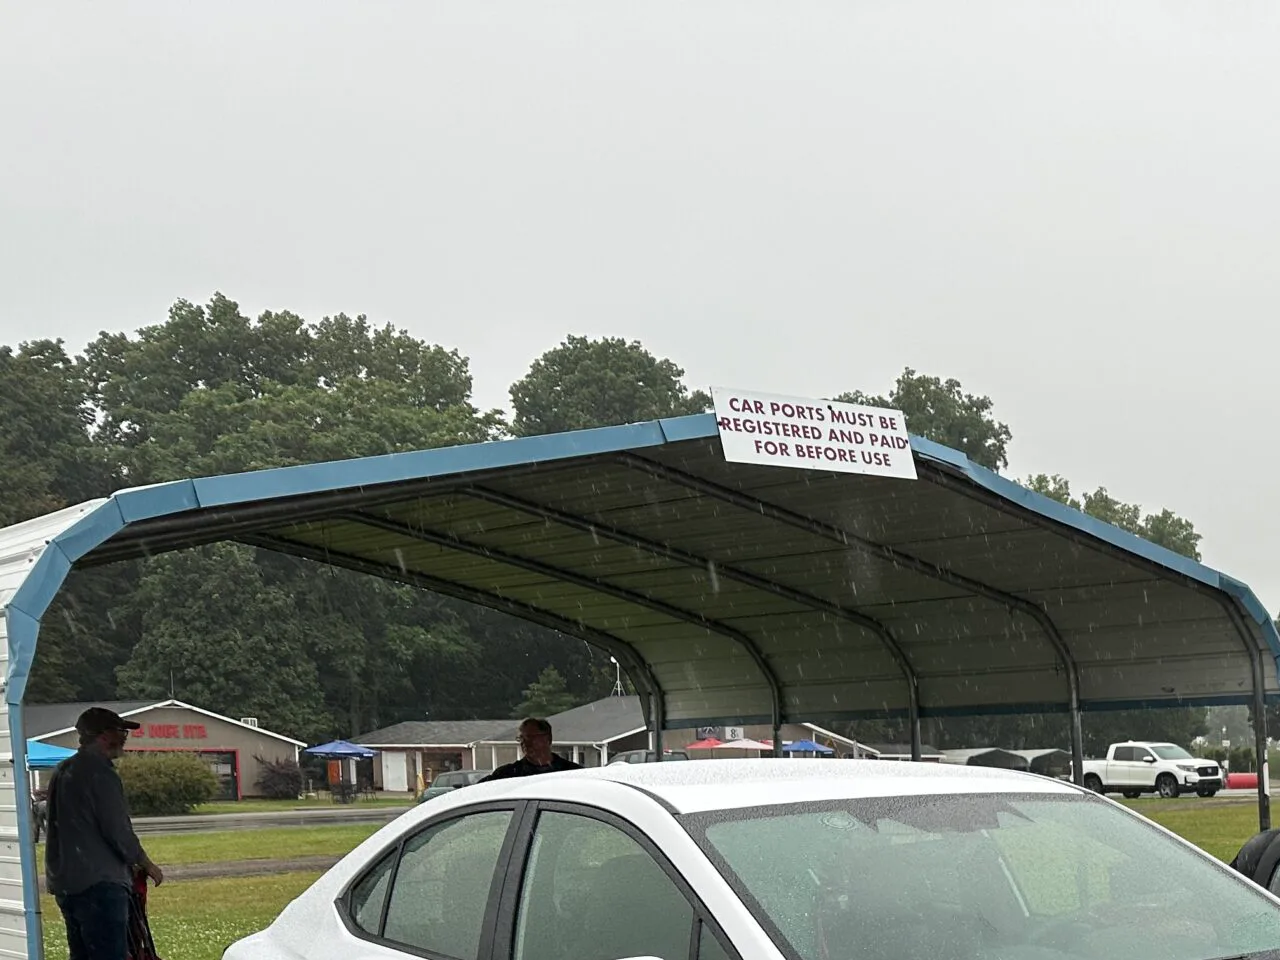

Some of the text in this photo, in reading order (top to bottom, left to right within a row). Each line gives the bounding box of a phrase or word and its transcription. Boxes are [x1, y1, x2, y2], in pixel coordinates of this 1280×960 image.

[729, 397, 898, 430] CAR PORTS MUST BE
[722, 416, 906, 450] REGISTERED AND PAID
[755, 440, 891, 467] FOR BEFORE USE
